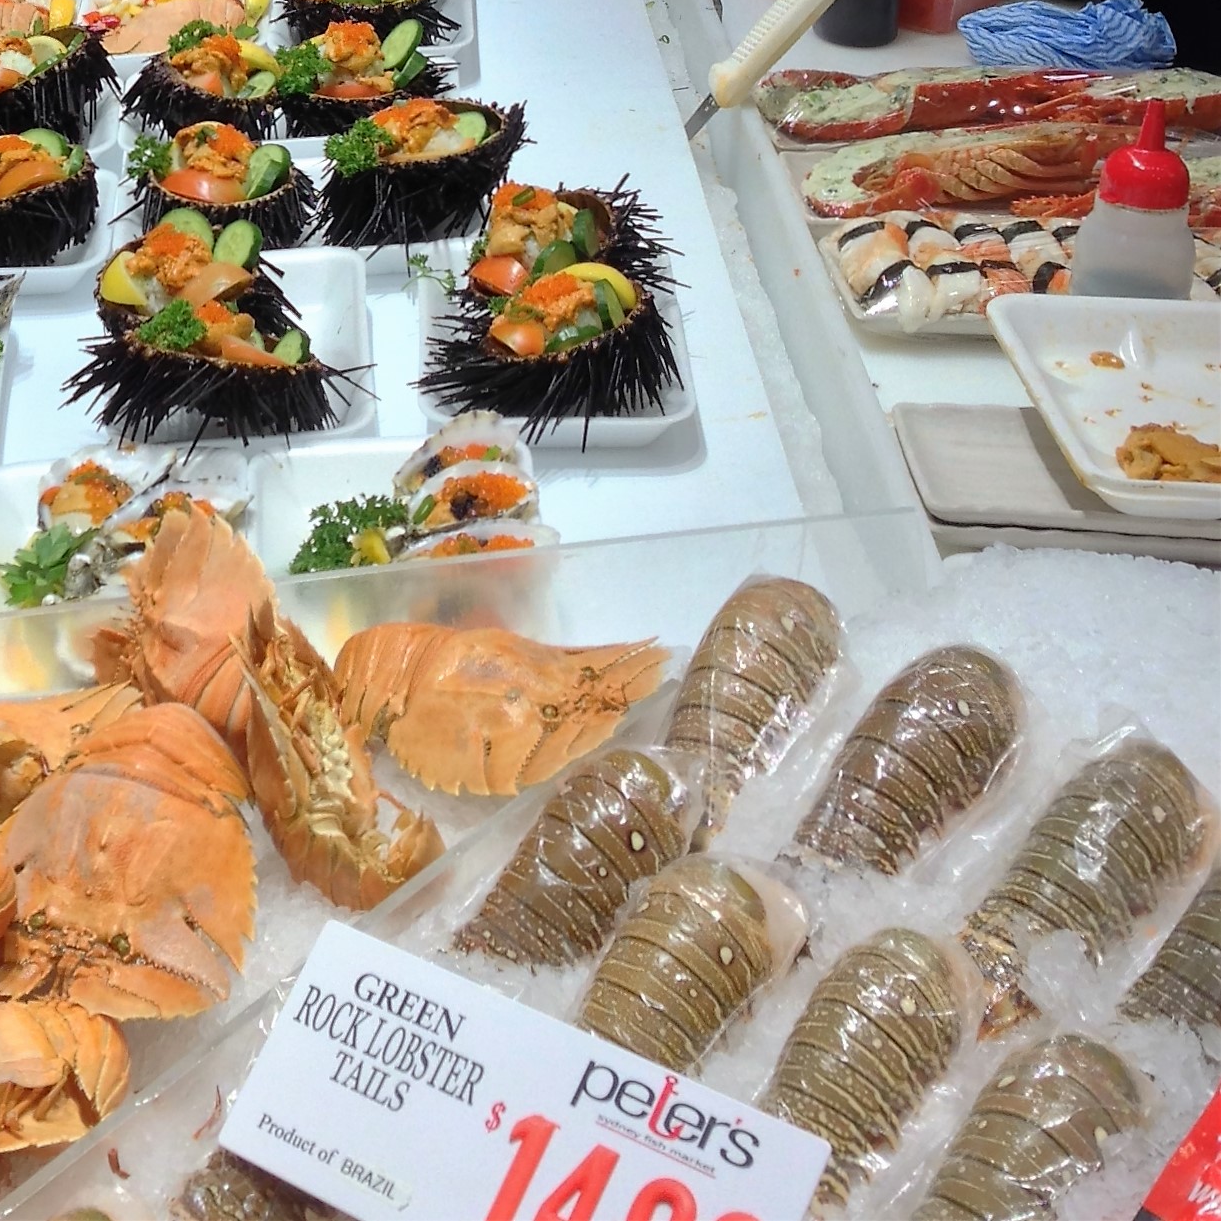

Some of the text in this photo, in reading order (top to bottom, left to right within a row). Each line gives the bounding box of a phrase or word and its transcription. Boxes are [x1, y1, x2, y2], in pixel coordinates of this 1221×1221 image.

[293, 985, 485, 1106] ROCK LOBSTER
[354, 973, 467, 1043] GREEN
[330, 1051, 411, 1112] TAILS
[570, 1060, 760, 1169] peter's
[257, 1113, 395, 1201] Product of BRAZIL
[597, 1113, 717, 1174] sydney fish market
